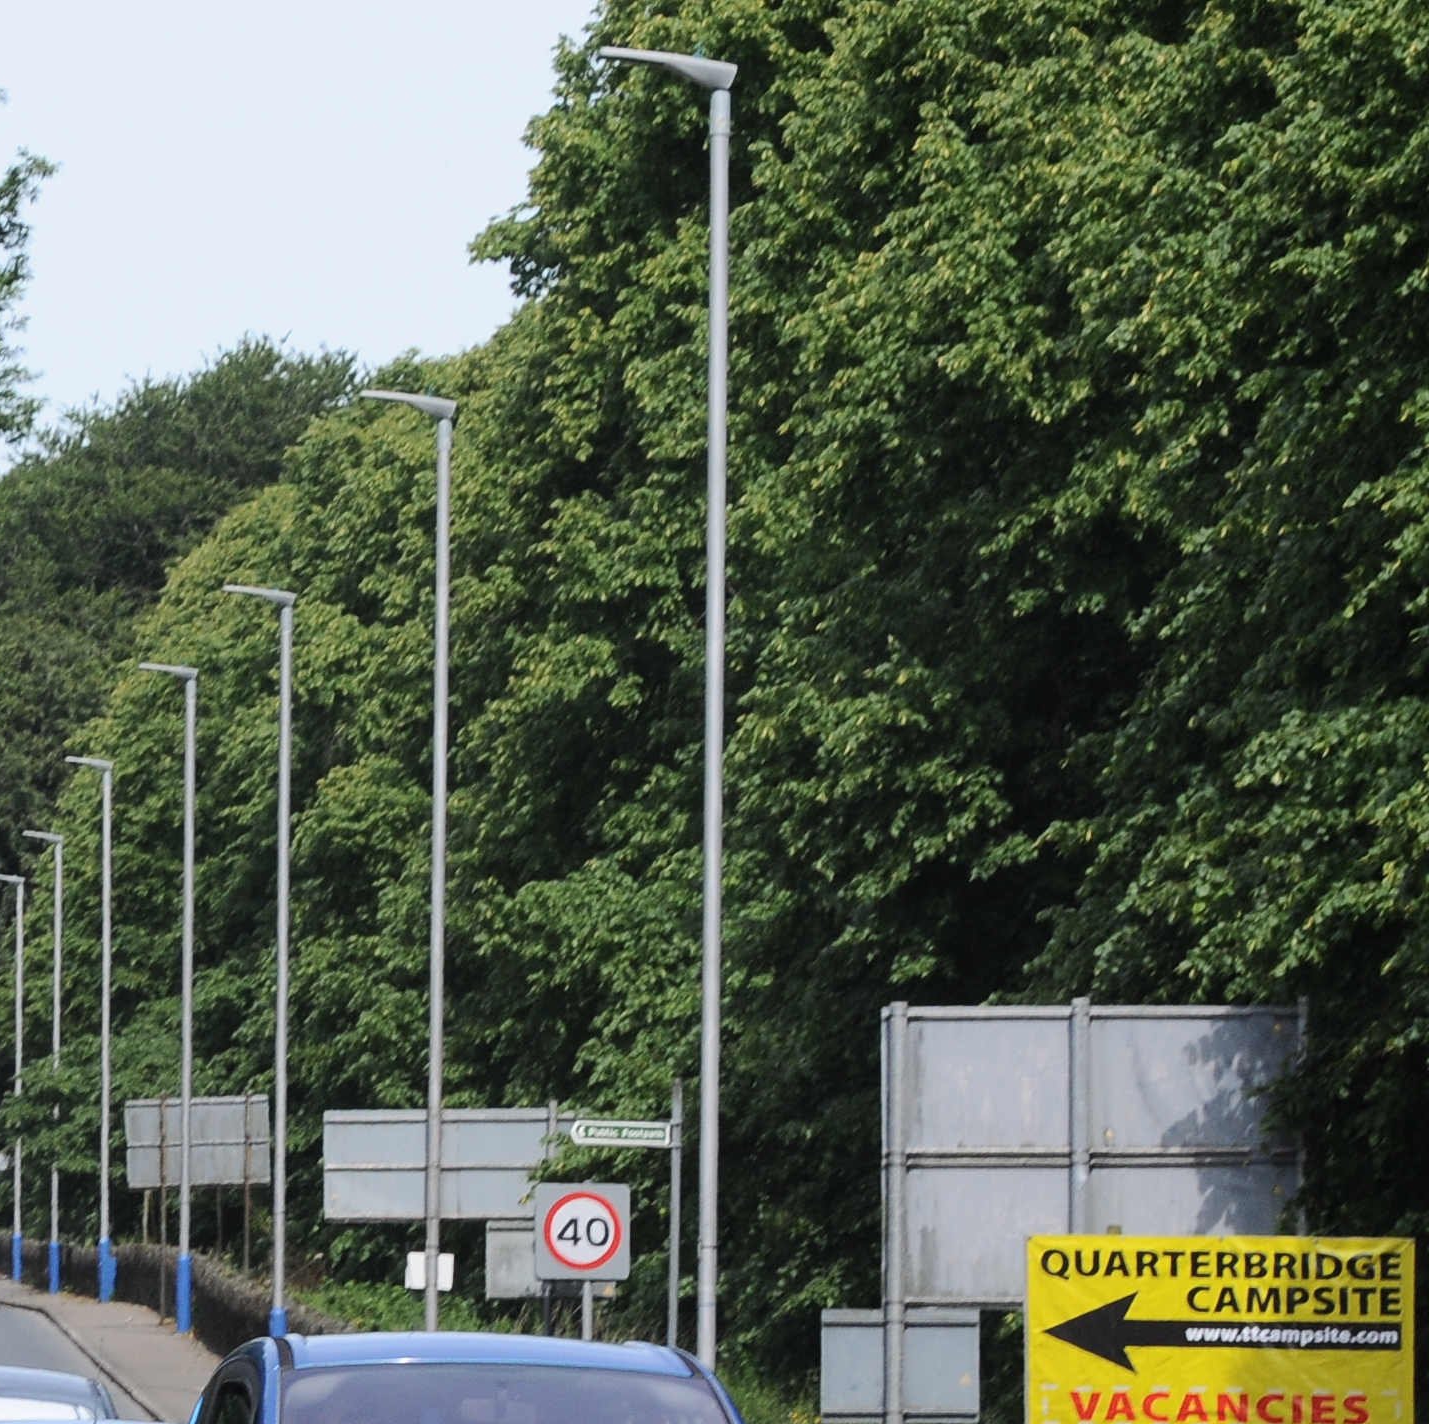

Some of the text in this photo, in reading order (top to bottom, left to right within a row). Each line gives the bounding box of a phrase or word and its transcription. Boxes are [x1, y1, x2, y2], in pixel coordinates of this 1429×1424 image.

[557, 1217, 609, 1247] 40
[1041, 1248, 1402, 1281] QUARTERBRIDGE
[1186, 1286, 1402, 1316] CAMPSITE
[1185, 1326, 1398, 1347] www.ttcampsite.com
